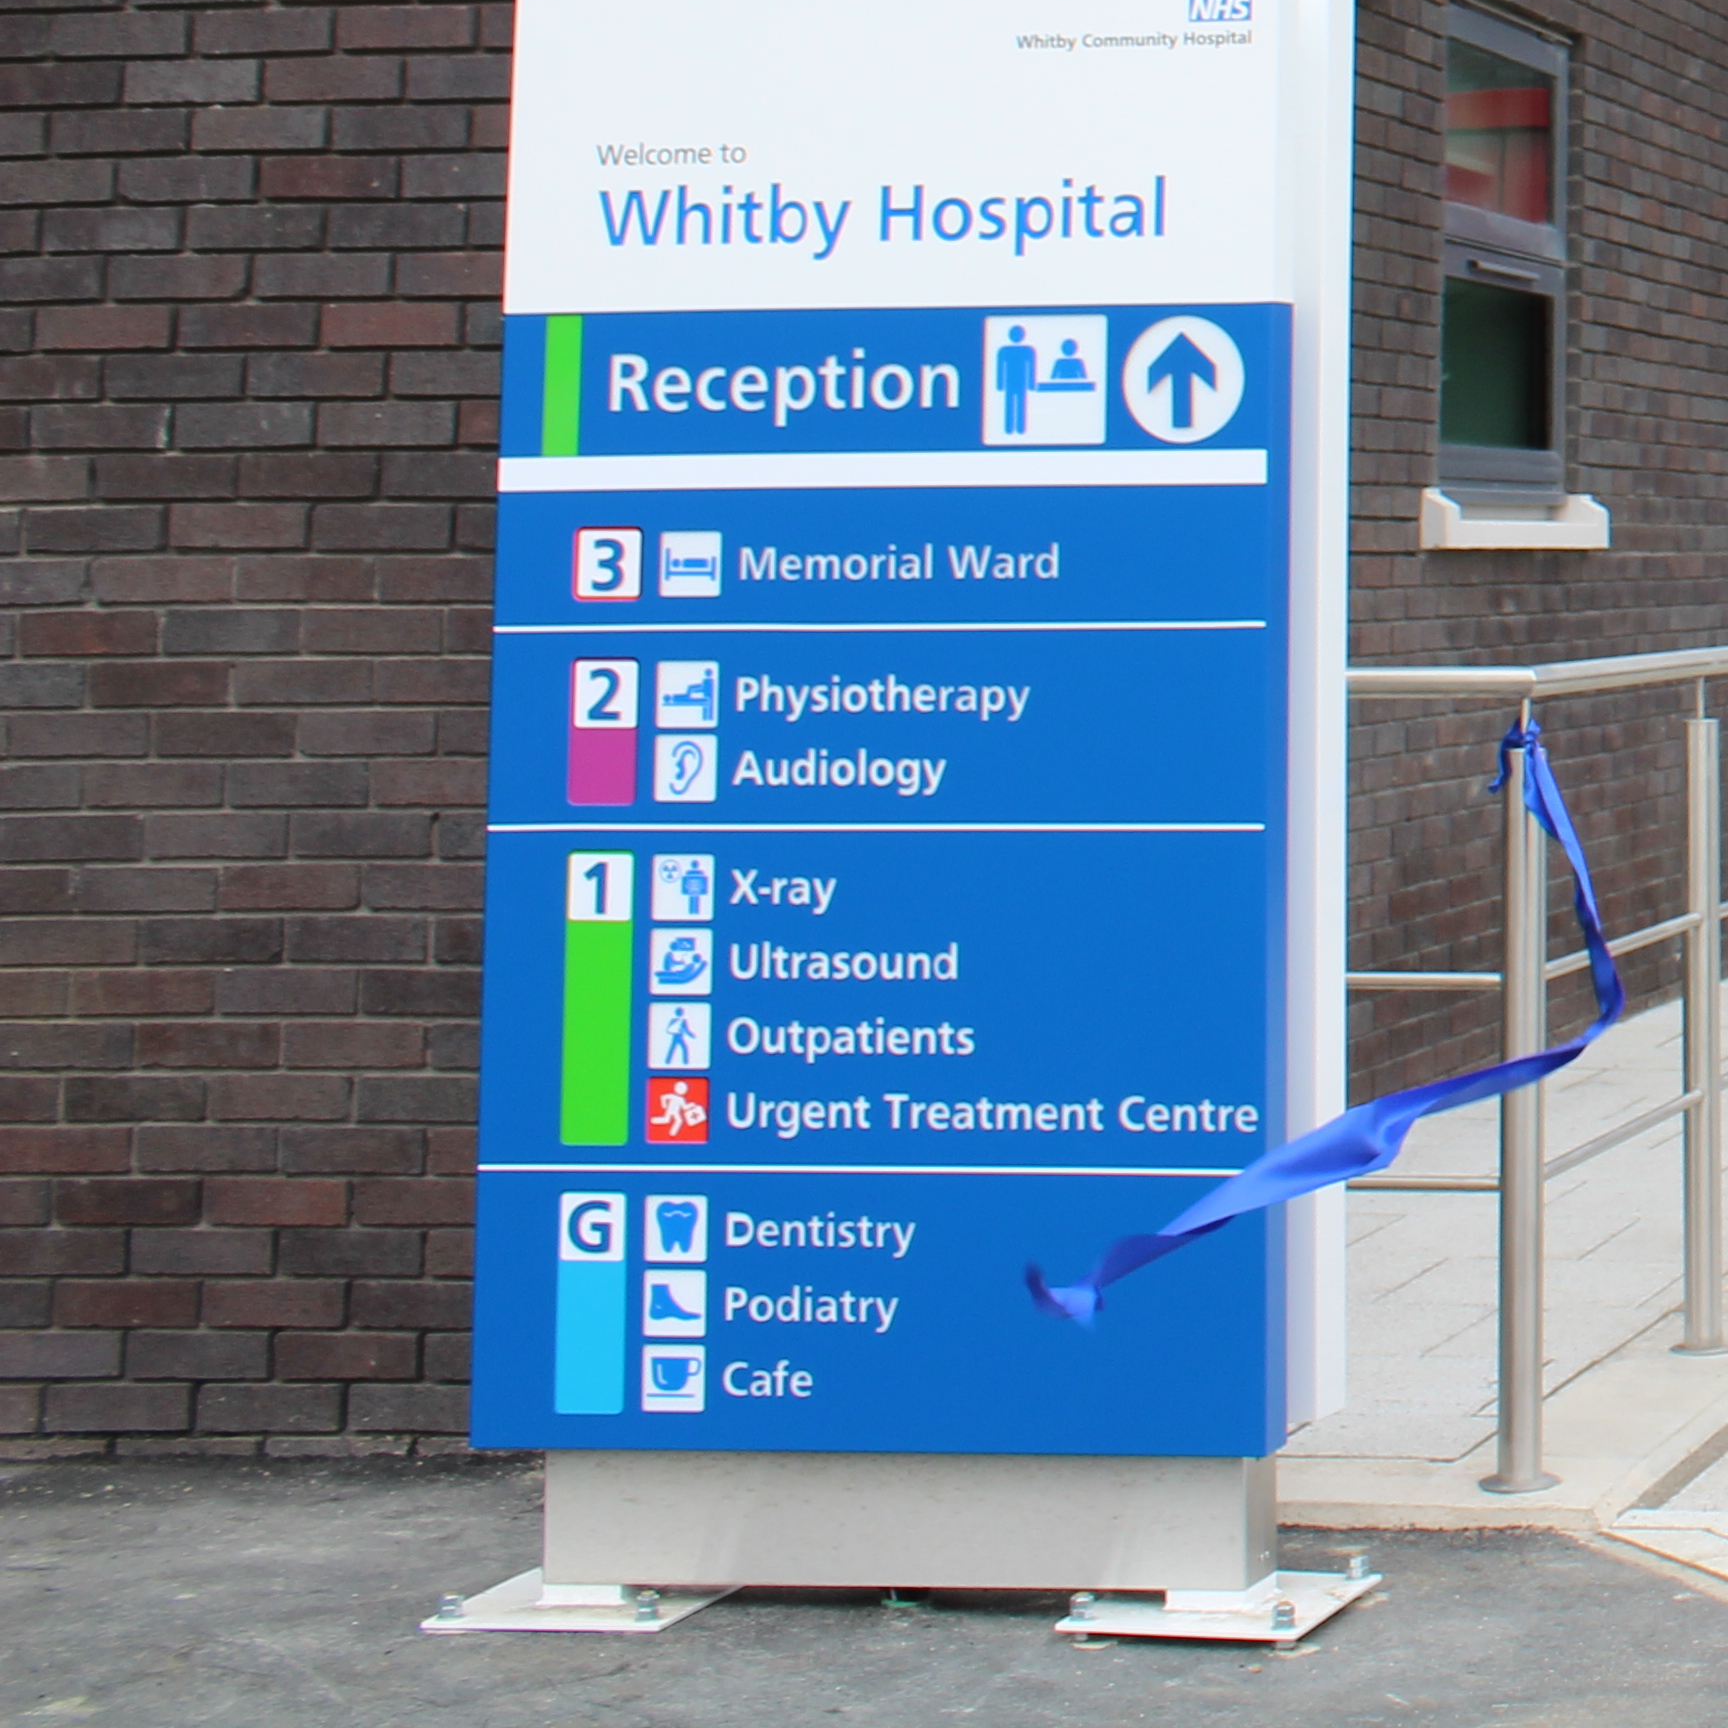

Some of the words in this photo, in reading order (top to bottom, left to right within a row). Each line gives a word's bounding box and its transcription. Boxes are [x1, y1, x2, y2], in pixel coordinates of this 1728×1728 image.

[1016, 34, 1075, 52] Whitby
[1082, 31, 1177, 49] Community
[1183, 29, 1252, 48] Hospital
[596, 143, 710, 166] Welcome
[718, 144, 745, 163] to
[599, 183, 851, 260] Whitby
[880, 175, 1166, 256] Hospital
[608, 348, 958, 427] Reception
[590, 538, 625, 591] 3
[739, 544, 932, 580] Memorial
[948, 543, 1058, 579] Ward
[587, 669, 618, 721] 2
[736, 675, 1029, 722] Physiotherapy
[732, 748, 945, 796] Audiology
[584, 862, 608, 915] 1
[730, 870, 836, 915] X-ray
[730, 942, 957, 980] Ultrasound
[727, 1018, 974, 1064] Outpatients
[727, 1093, 870, 1139] Urgent
[883, 1094, 1103, 1131] Treatment
[1118, 1096, 1258, 1133] Centre
[568, 1201, 610, 1254] G
[725, 1212, 914, 1258] Dentistry
[724, 1286, 897, 1333] Podiatry
[722, 1360, 812, 1398] Cafe
